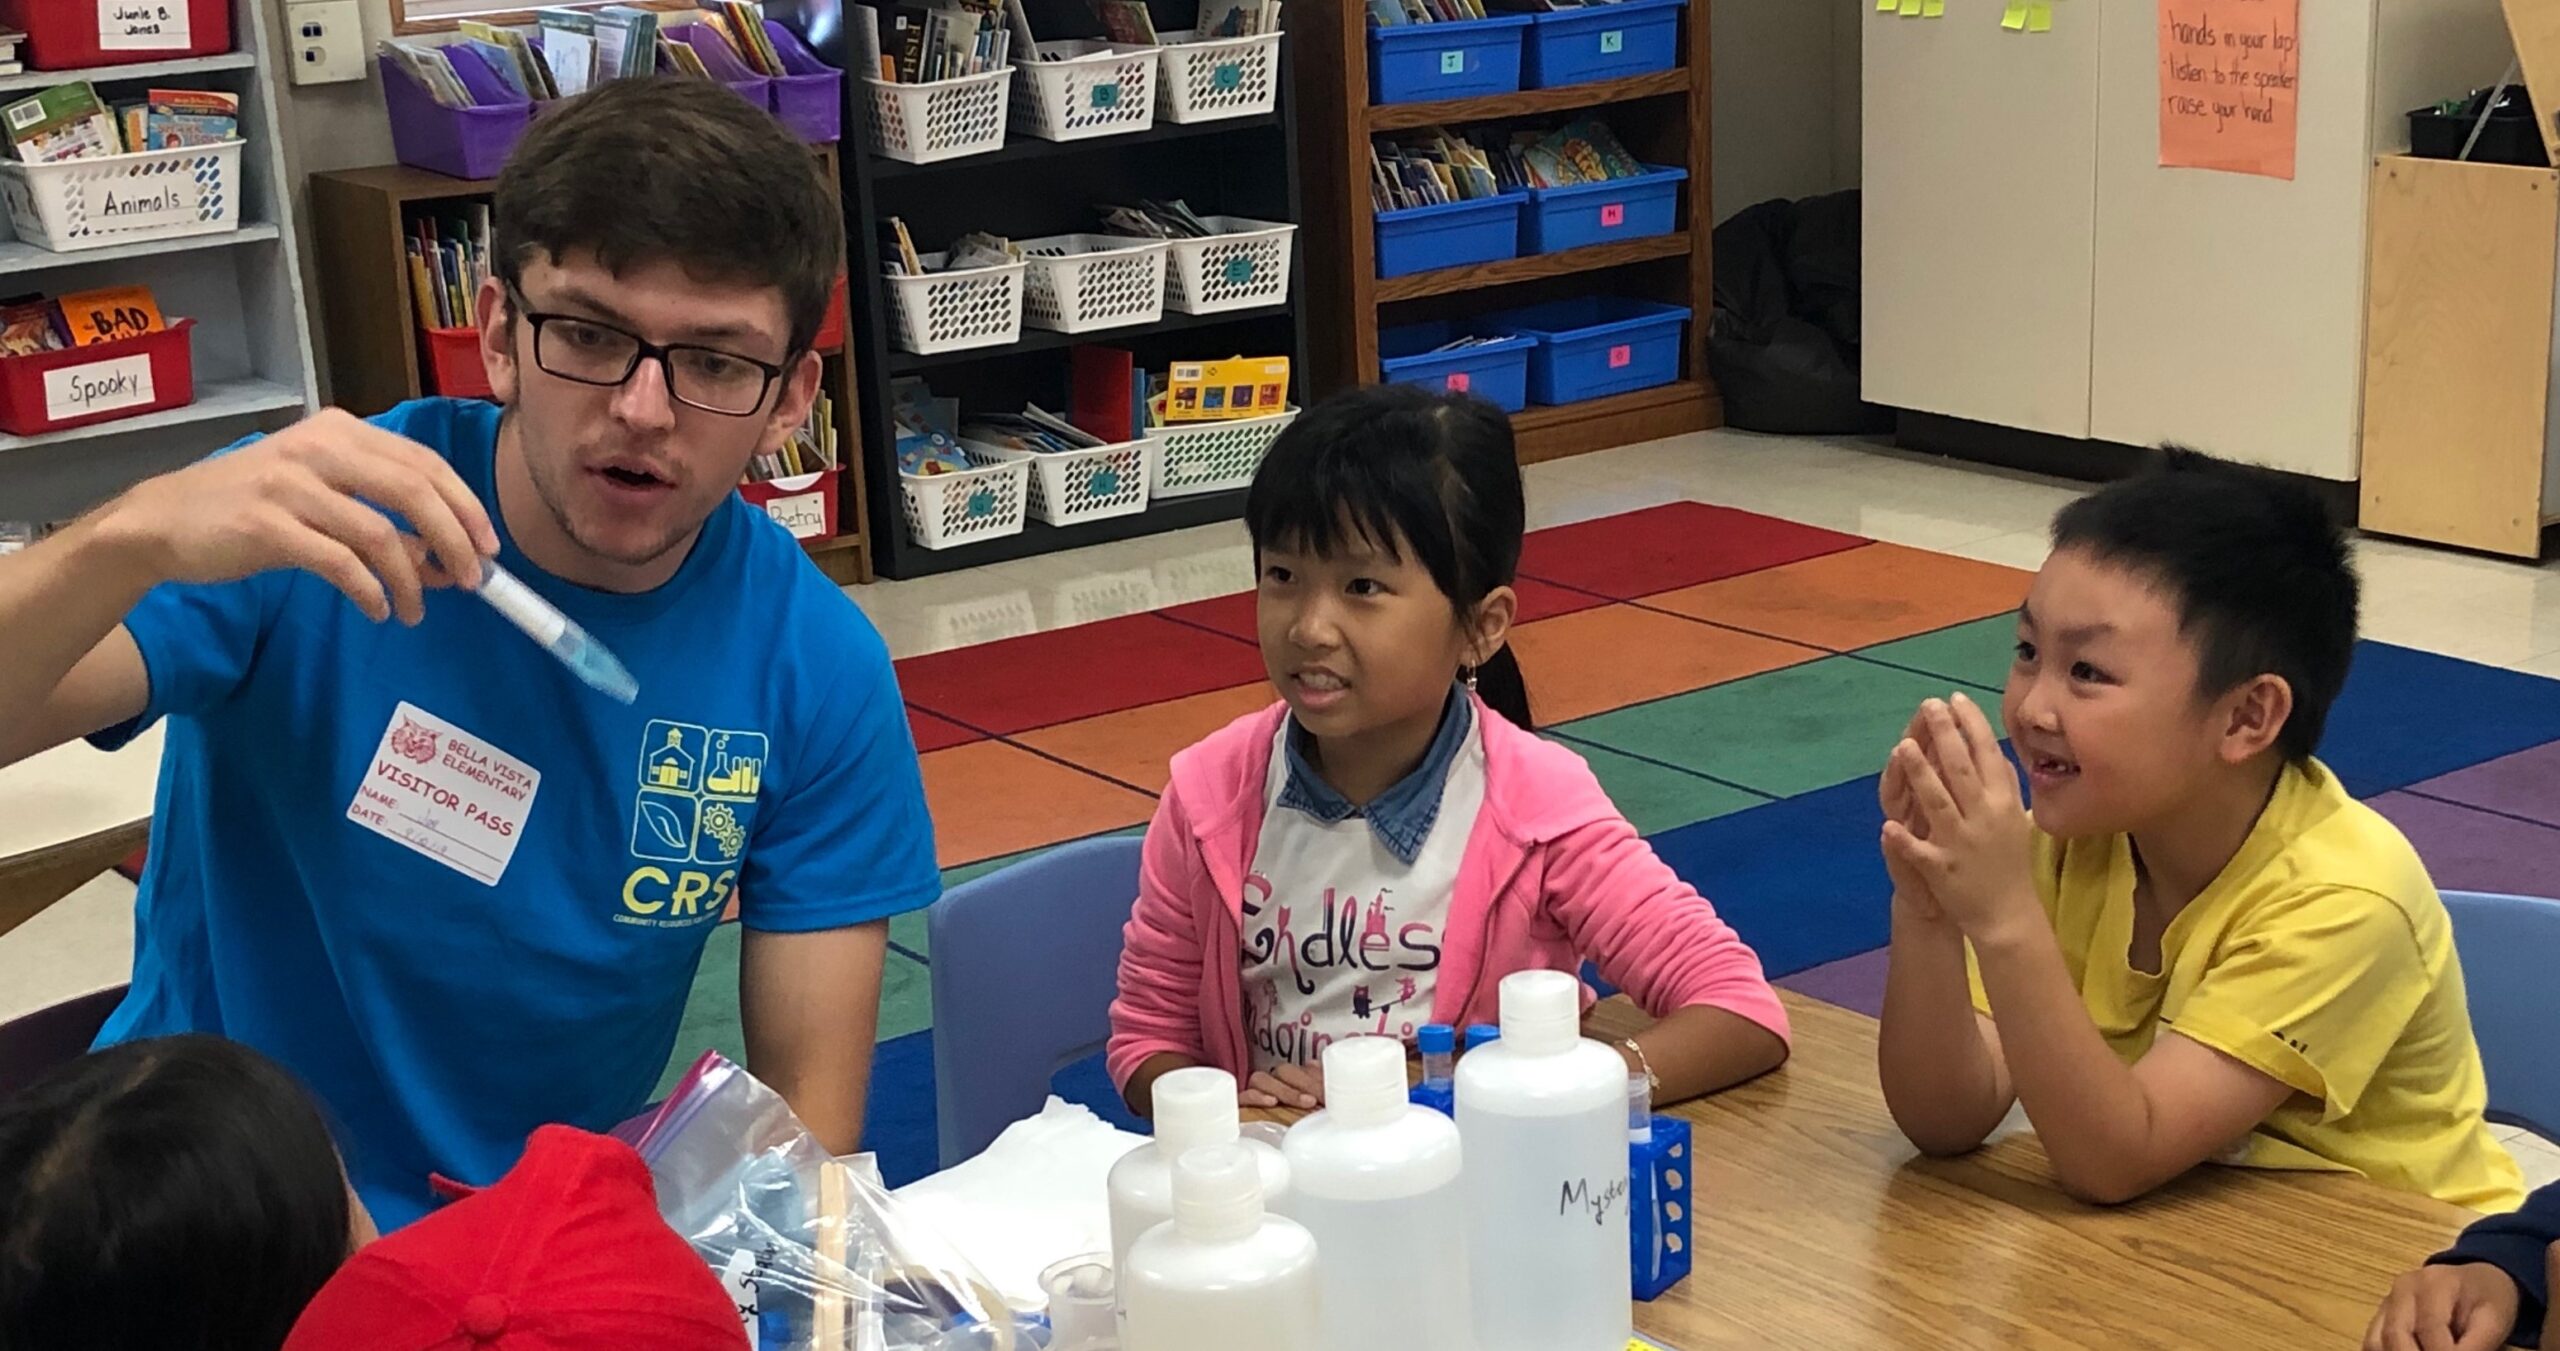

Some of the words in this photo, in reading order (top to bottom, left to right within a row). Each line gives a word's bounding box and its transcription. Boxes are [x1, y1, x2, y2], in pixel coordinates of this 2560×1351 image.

[124, 24, 160, 35] Jones
[1605, 35, 1614, 47] K
[2168, 9, 2216, 47] hands
[2239, 32, 2267, 61] your
[2273, 16, 2296, 63] lap
[2169, 52, 2207, 83] listen
[2212, 54, 2226, 85] to
[2230, 55, 2249, 86] the
[2254, 60, 2297, 99] speaker
[2168, 95, 2207, 117] raise
[2212, 101, 2239, 134] your
[2240, 91, 2274, 124] hand
[104, 185, 180, 216] Animals
[90, 307, 150, 335] BAD
[69, 370, 138, 408] Spooky
[443, 753, 527, 802] ELEMENTARY
[448, 739, 488, 767] BELLA
[493, 760, 532, 790] VISTA
[377, 760, 460, 811] VISITOR
[464, 803, 514, 837] PASS
[622, 866, 736, 915] CRS
[1242, 872, 1445, 995] Endles
